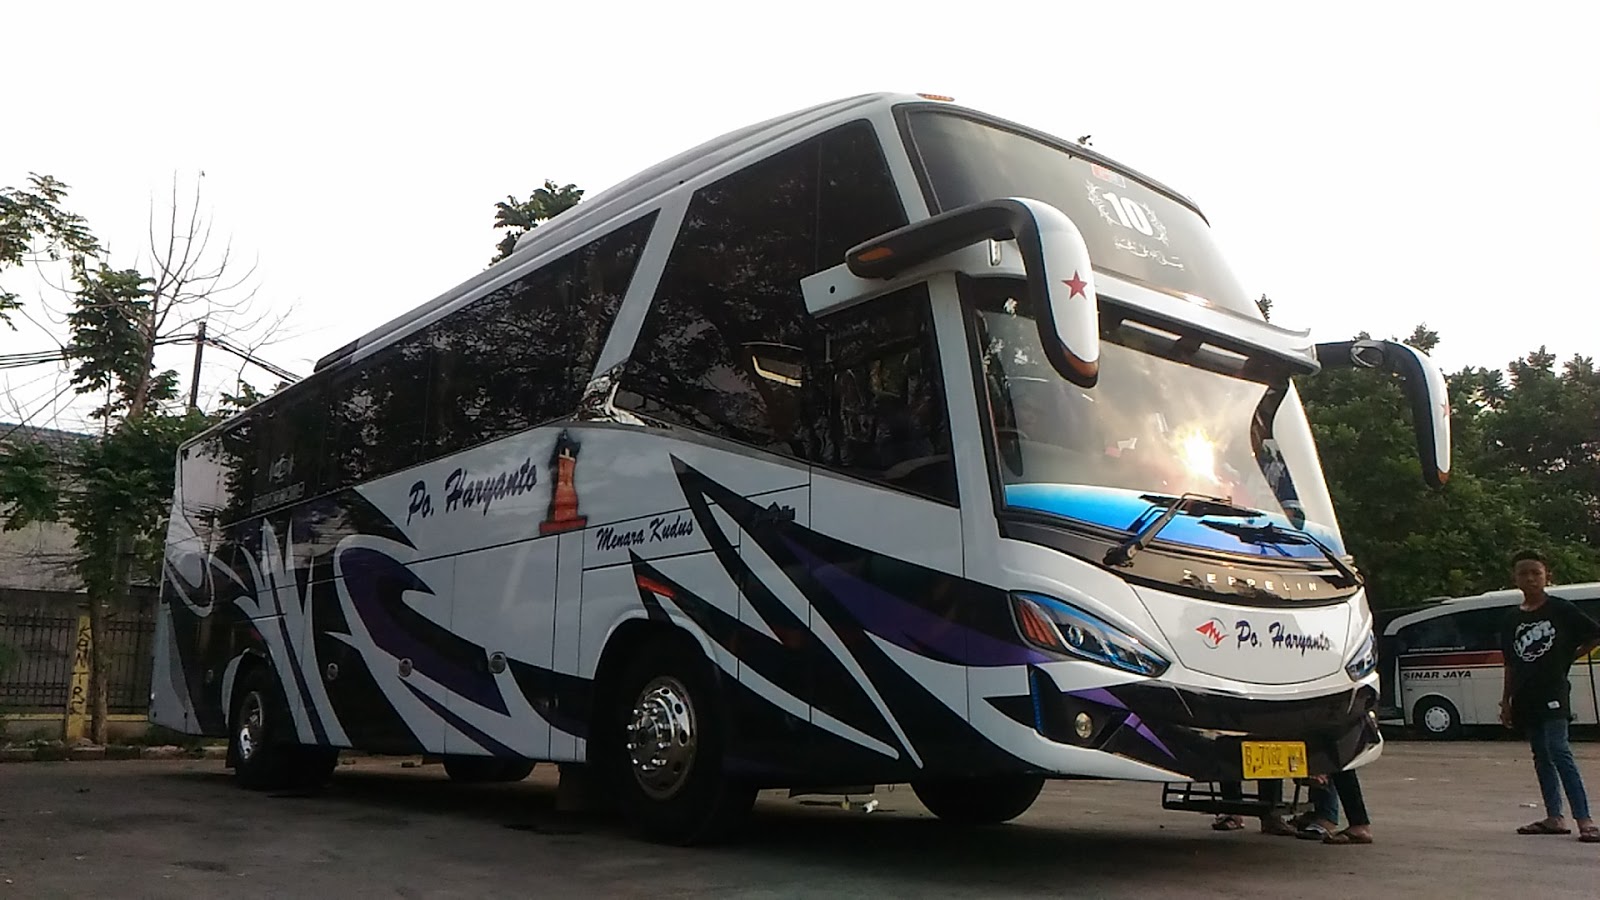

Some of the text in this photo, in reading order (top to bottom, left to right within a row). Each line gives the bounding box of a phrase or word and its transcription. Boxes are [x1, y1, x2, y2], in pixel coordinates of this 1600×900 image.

[1102, 192, 1153, 236] 10
[445, 457, 537, 516] Haryanto
[596, 515, 693, 551] Menara Kudus
[1183, 569, 1317, 591] ZEPPELIN
[1235, 620, 1262, 649] Po.
[1269, 622, 1331, 657] Haryanto
[1403, 670, 1472, 679] SINAR JAYA
